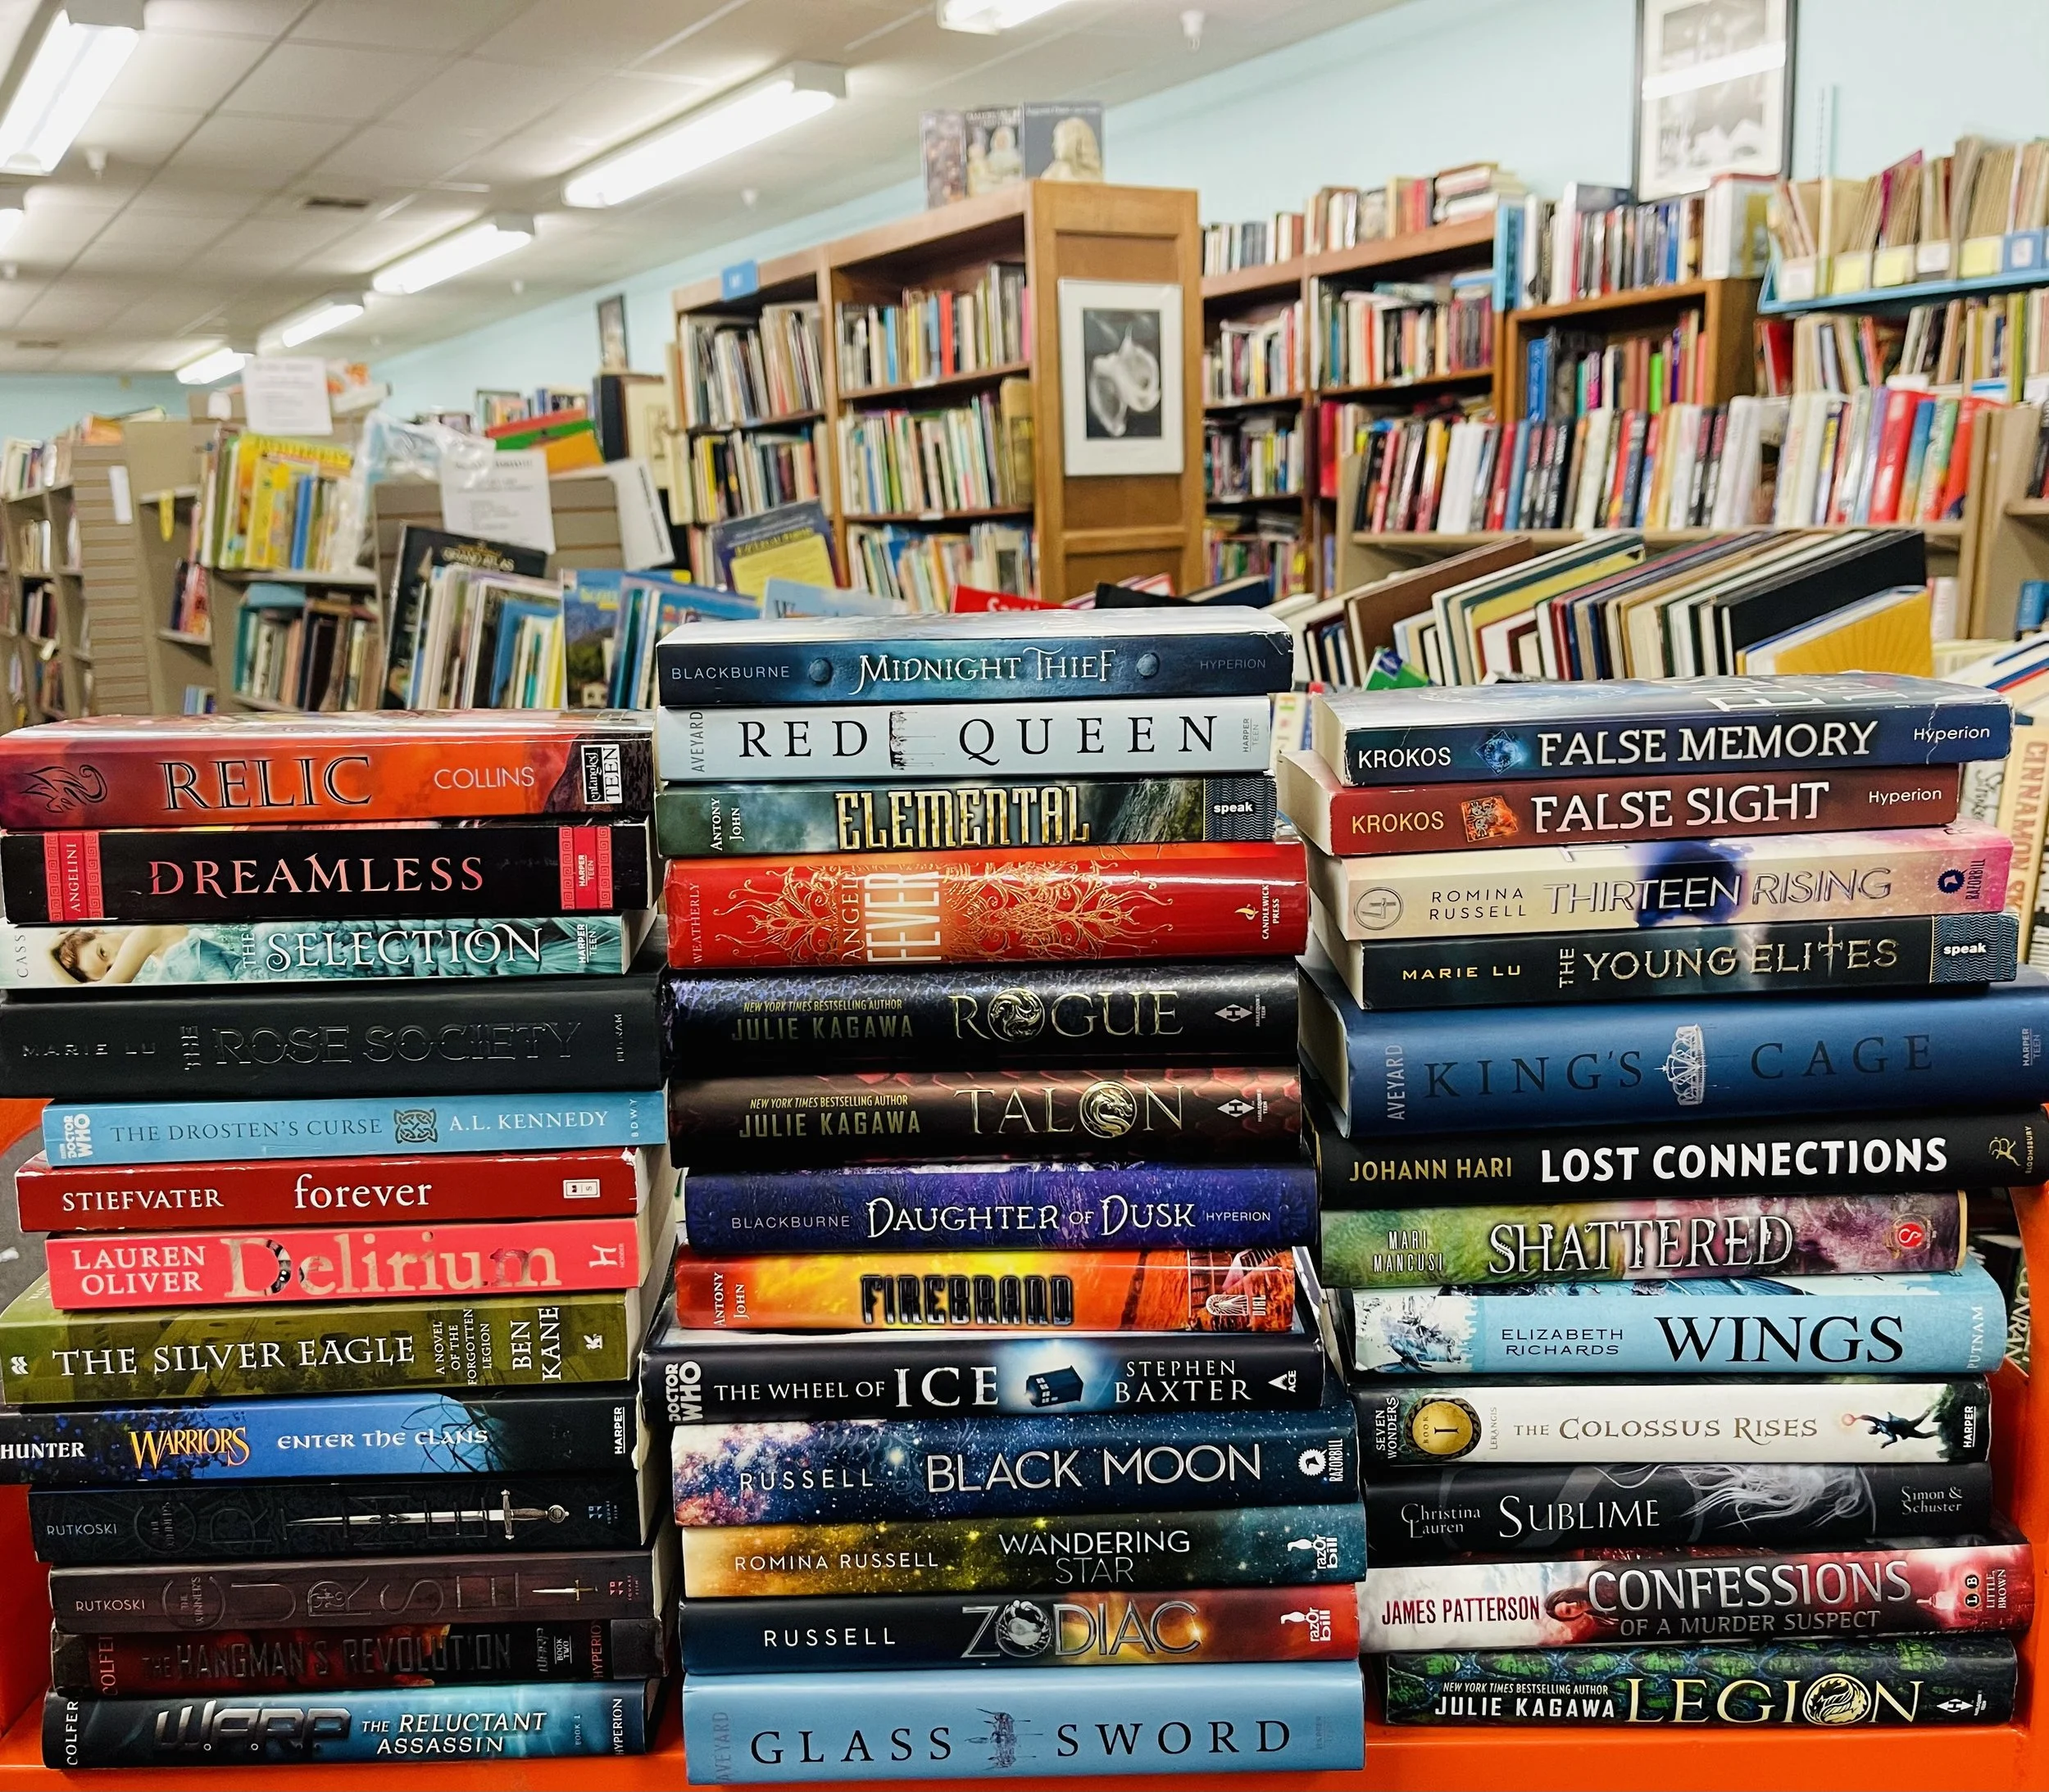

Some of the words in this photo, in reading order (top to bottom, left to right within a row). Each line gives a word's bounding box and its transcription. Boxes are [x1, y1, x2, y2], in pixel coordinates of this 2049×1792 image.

[672, 666, 790, 680] BLACKBURNE
[848, 655, 1021, 696] MIDNIGHT
[1200, 659, 1266, 670] HYPERION
[689, 711, 706, 773] AVEYARD
[738, 720, 868, 758] RED
[1537, 728, 1667, 768] FALSE
[1678, 720, 1879, 762] MEMORY
[1914, 726, 1991, 744] Hyperion
[585, 751, 602, 801] entangled
[603, 746, 620, 802] TEEN
[1358, 746, 1452, 769] KROKOS
[158, 755, 373, 810] RELIC
[434, 767, 535, 791] COLLINS
[1869, 788, 1942, 805] Hyperion
[710, 797, 723, 852] ANTONY
[730, 807, 744, 842] JOHN
[835, 786, 1090, 850] ELEMENTAL
[1213, 801, 1253, 814] speak
[1352, 811, 1445, 834] KROKOS
[1530, 790, 1674, 834] FALSE
[1685, 782, 1829, 826] SIGHT
[68, 842, 81, 912] ANGELINI
[149, 854, 484, 899] DREAMLESS
[1432, 887, 1524, 903] ROMINA
[1543, 874, 1741, 914] THIRTEEN
[1751, 867, 1892, 905] RISING
[1965, 859, 1985, 900] RAZORBILL
[693, 882, 702, 964] WEATHERLY
[1429, 905, 1527, 920] RUSSELL
[15, 934, 29, 978] CASS
[243, 929, 255, 968] THE
[266, 923, 543, 970] SELECTION
[578, 923, 586, 964] HARPER
[1943, 942, 1987, 955] speak
[1402, 968, 1479, 980] MARIE
[1492, 965, 1521, 977] LU
[1559, 948, 1575, 988] THE
[1583, 945, 1738, 982] YOUNG
[743, 1002, 762, 1013] NEW
[764, 1001, 786, 1012] YORK
[788, 1000, 812, 1011] TIMES
[814, 1000, 866, 1011] BESTSELLING
[869, 999, 902, 1009] AUTHOR
[732, 1017, 799, 1041] JULIE
[812, 1015, 913, 1039] KAGAWA
[2022, 1028, 2030, 1066] HARPER
[1386, 1044, 1406, 1121] AVEYARD
[1424, 1050, 1642, 1099] KING'S
[1751, 1034, 1931, 1081] CAGE
[750, 1099, 769, 1109] NEW
[770, 1098, 793, 1109] YORK
[794, 1097, 819, 1108] TIMES
[820, 1096, 872, 1108] BESTSELLING
[874, 1095, 908, 1105] AUTHOR
[74, 1113, 93, 1158] WHO
[111, 1126, 160, 1141] THE
[169, 1120, 298, 1140] DROSTEN'S
[307, 1118, 383, 1136] CURSE
[450, 1116, 491, 1132] A.L.
[498, 1111, 609, 1129] KENNEDY
[739, 1114, 807, 1138] JULIE
[820, 1111, 920, 1136] KAGAWA
[1350, 1159, 1447, 1182] JOHANN
[1456, 1157, 1512, 1178] HARI
[1541, 1147, 1639, 1183] LOST
[1652, 1137, 1947, 1179] CONNECTIONS
[62, 1189, 224, 1211] STIEFVATER
[294, 1173, 432, 1209] forever
[732, 1215, 851, 1229] BLACKBURNE
[865, 1197, 1061, 1238] DAUGHTER
[1069, 1210, 1094, 1224] OF
[1100, 1195, 1195, 1236] DUSK
[1206, 1211, 1271, 1222] HYPERION
[71, 1246, 206, 1270] LAUREN
[1388, 1231, 1428, 1250] MARI
[1488, 1215, 1793, 1276] SHATTERED
[220, 1231, 561, 1298] Delirium
[1373, 1253, 1444, 1273] MANCUSI
[81, 1272, 203, 1295] OLIVER
[713, 1272, 726, 1327] ANTONY
[734, 1283, 750, 1319] JOHN
[860, 1274, 1074, 1326] FIREBRAND
[1252, 1295, 1265, 1316] DIAL
[433, 1321, 444, 1360] NOVEL
[463, 1309, 477, 1386] FORGOTTEN
[481, 1322, 492, 1369] LEGION
[510, 1320, 532, 1370] BEN
[538, 1307, 561, 1381] KANE
[1502, 1329, 1624, 1341] ELIZABETH
[1506, 1345, 1620, 1356] RICHARDS
[1654, 1315, 1904, 1364] WINGS
[1967, 1305, 1983, 1370] PUTNAM
[52, 1347, 137, 1376] THE
[154, 1342, 285, 1374] SILVER
[298, 1336, 416, 1366] EAGLE
[1126, 1359, 1235, 1377] STEPHEN
[665, 1363, 681, 1422] DOCTOR
[679, 1361, 702, 1421] WHO
[714, 1384, 761, 1401] THE
[767, 1383, 848, 1400] WHEEL
[856, 1381, 885, 1397] OF
[894, 1367, 998, 1408] ICE
[1114, 1379, 1253, 1404] BAXTER
[614, 1406, 623, 1454] HARPER
[1376, 1409, 1386, 1451] SEVEN
[1388, 1397, 1400, 1459] WONDERS
[1514, 1424, 1549, 1436] THE
[1560, 1416, 1721, 1440] COLOSSUS
[1733, 1417, 1818, 1446] RISES
[1963, 1405, 1974, 1449] HARPER
[1, 1442, 85, 1459] HUNTER
[928, 1449, 1083, 1494] BLACK
[1102, 1444, 1261, 1485] MOON
[1329, 1438, 1343, 1482] RAZORBILL
[740, 1468, 874, 1491] RUSSELL
[1901, 1486, 1944, 1501] Simon
[1401, 1503, 1481, 1524] Christina
[1499, 1495, 1661, 1538] SUBLIME
[1901, 1500, 1963, 1515] Schuster
[47, 1523, 116, 1536] RUTKOSKI
[998, 1531, 1190, 1555] WANDERING
[735, 1555, 828, 1571] ROMINA
[840, 1552, 938, 1569] RUSSELL
[1055, 1557, 1134, 1584] STAR
[1588, 1560, 1911, 1613] CONFESSIONS
[1998, 1569, 2006, 1608] BROWN
[75, 1599, 145, 1613] RUTKOSKI
[1382, 1600, 1436, 1625] JAMES
[1443, 1596, 1539, 1623] PATTERSON
[1620, 1618, 1648, 1636] OF
[1681, 1615, 1775, 1634] MURDER
[1783, 1610, 1881, 1631] SUSPECT
[764, 1627, 896, 1647] RUSSELL
[1435, 1696, 1502, 1717] JULIE
[1516, 1698, 1615, 1718] KAGAWA
[1443, 1682, 1463, 1694] NEW
[1465, 1683, 1488, 1694] YORK
[1489, 1683, 1514, 1694] TIMES
[1516, 1684, 1571, 1694] BESTSELLING
[1573, 1685, 1608, 1695] AUTHOR
[66, 1701, 79, 1765] COLFER
[361, 1720, 389, 1732] THE
[399, 1713, 547, 1732] RELUCTANT
[612, 1698, 624, 1756] HYPERION
[376, 1737, 504, 1754] ASSASSIN
[711, 1711, 729, 1782] AVEYARD
[751, 1726, 952, 1765] GLASS
[1057, 1720, 1291, 1757] SWORD
